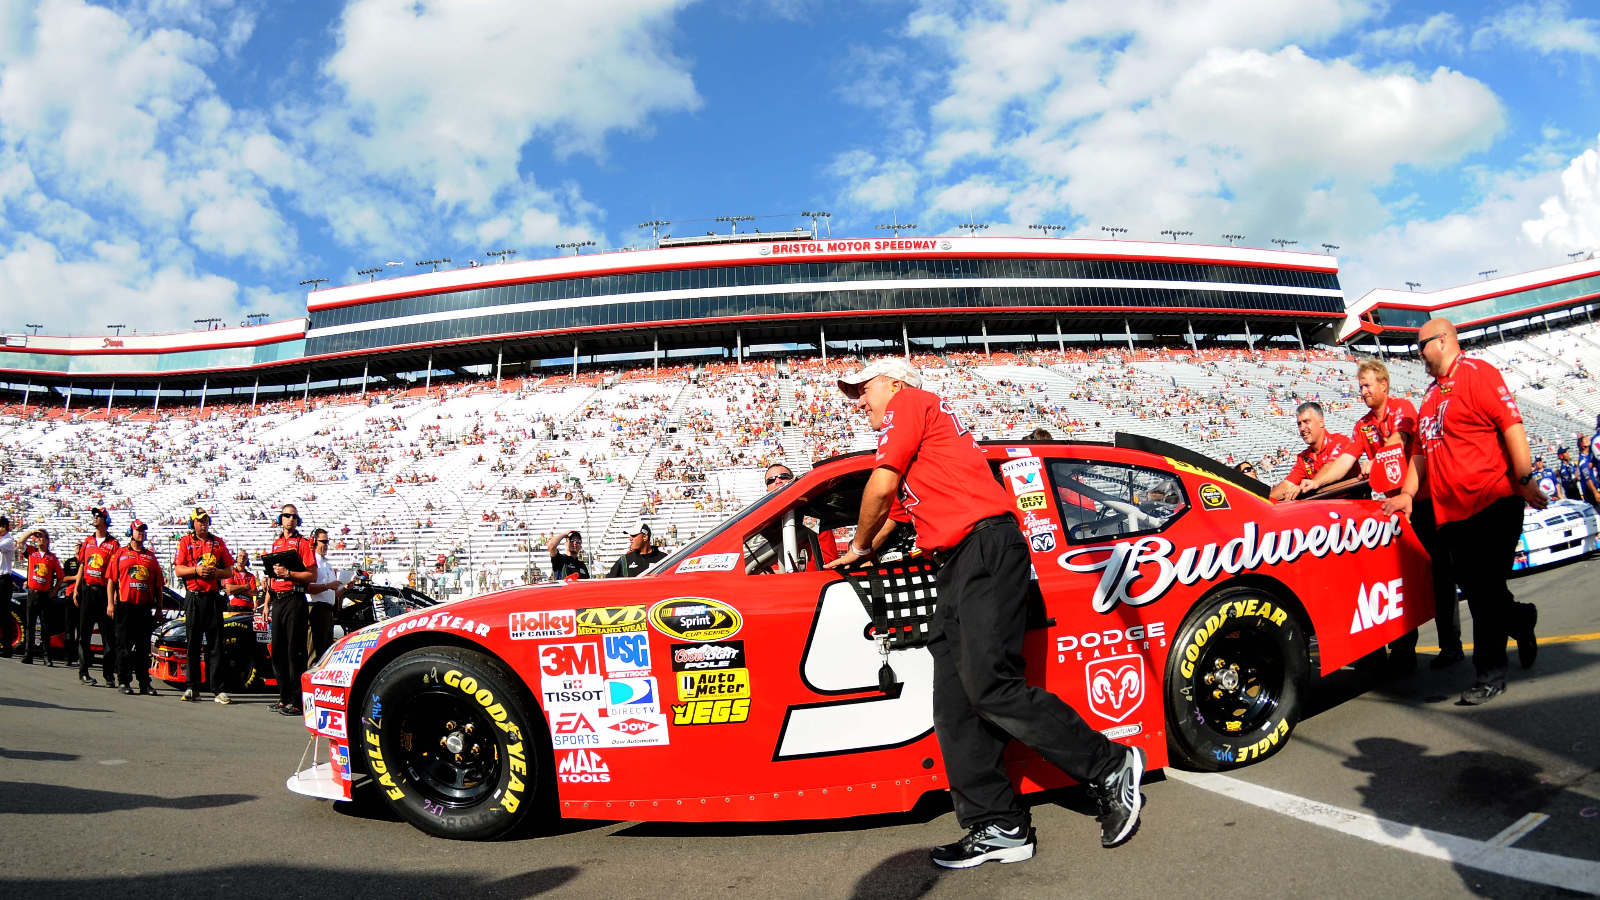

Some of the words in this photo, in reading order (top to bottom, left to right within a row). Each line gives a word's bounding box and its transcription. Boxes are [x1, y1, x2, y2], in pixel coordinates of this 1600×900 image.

[772, 243, 824, 254] BRISTOL
[827, 241, 871, 252] MOTOR
[874, 240, 937, 251] SPEEDWAY
[1375, 447, 1403, 459] DODGE
[1003, 460, 1040, 473] SIEMENS
[1020, 495, 1045, 503] BEST
[1022, 500, 1043, 508] BUY
[1031, 523, 1058, 534] BOSCH
[1056, 511, 1402, 614] Budweiser
[675, 605, 707, 616] NASCAR
[1350, 578, 1404, 634] ACE
[254, 622, 268, 631] 3M
[387, 612, 491, 638] GOODYEAR
[511, 613, 574, 635] Holley
[577, 626, 622, 635] MECHANIX
[622, 623, 648, 632] WEAR
[680, 616, 711, 628] Sprint
[1057, 621, 1166, 652] DODGE
[1180, 599, 1288, 679] GOODYEAR
[605, 634, 649, 668] USG
[675, 649, 705, 663] Coors
[706, 649, 739, 661] LIGHT
[1058, 638, 1167, 664] DEALERS
[542, 644, 597, 677] 3M
[684, 660, 731, 669] POLE
[314, 670, 343, 680] COMP
[608, 670, 649, 679] SHEETROCK
[698, 672, 736, 684] Auto
[314, 687, 345, 705] Edelbrock
[544, 690, 603, 702] TISSOT
[695, 683, 745, 697] Meter
[611, 707, 655, 716] DIRECTV
[671, 698, 752, 727] JEGS
[318, 710, 343, 731] JE
[555, 712, 597, 734] EA
[443, 669, 528, 814] GOODYEAR
[554, 734, 600, 746] SPORTS
[1235, 717, 1290, 763] EAGLE
[365, 729, 406, 801] EAGLE
[558, 749, 610, 773] MAC
[558, 774, 611, 783] TOOLS
